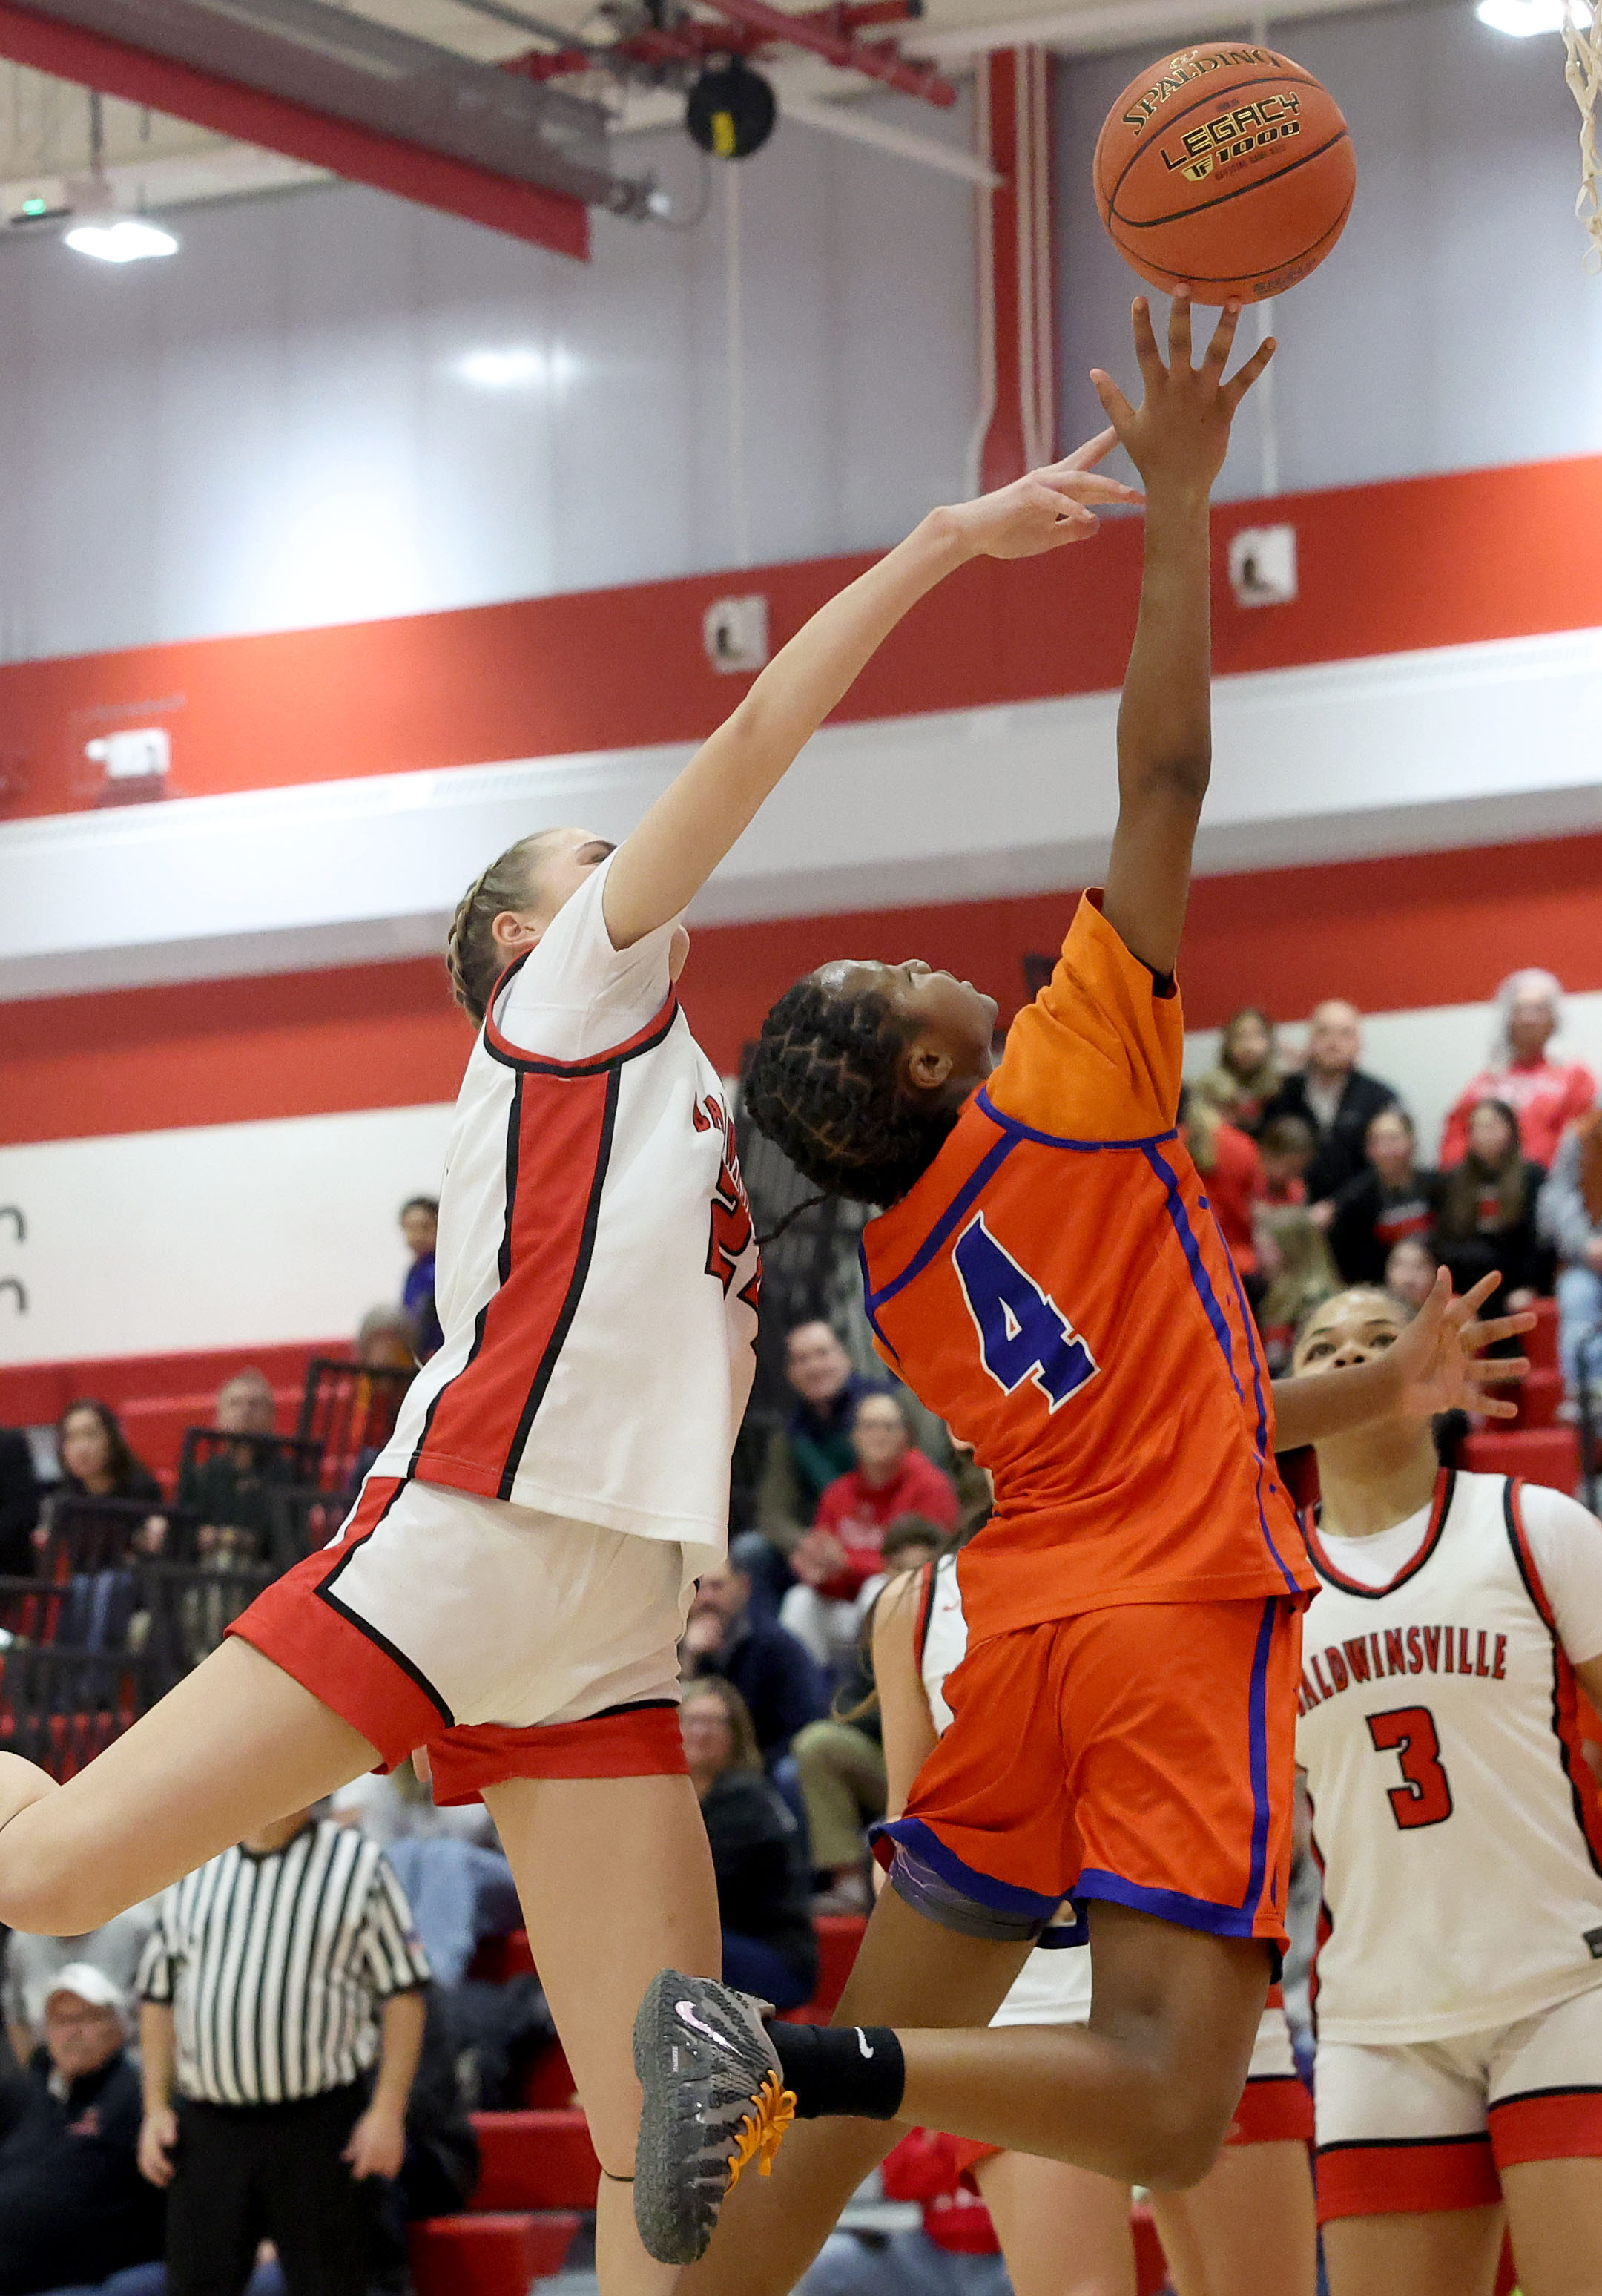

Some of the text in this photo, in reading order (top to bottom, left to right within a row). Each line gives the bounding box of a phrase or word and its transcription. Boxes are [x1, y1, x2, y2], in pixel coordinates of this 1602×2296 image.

[1123, 49, 1282, 136] SPALDING
[1160, 91, 1301, 172] LEGACY
[1216, 120, 1301, 165] 1000
[951, 1209, 1101, 1415] 4
[1365, 1705, 1453, 1830] 3
